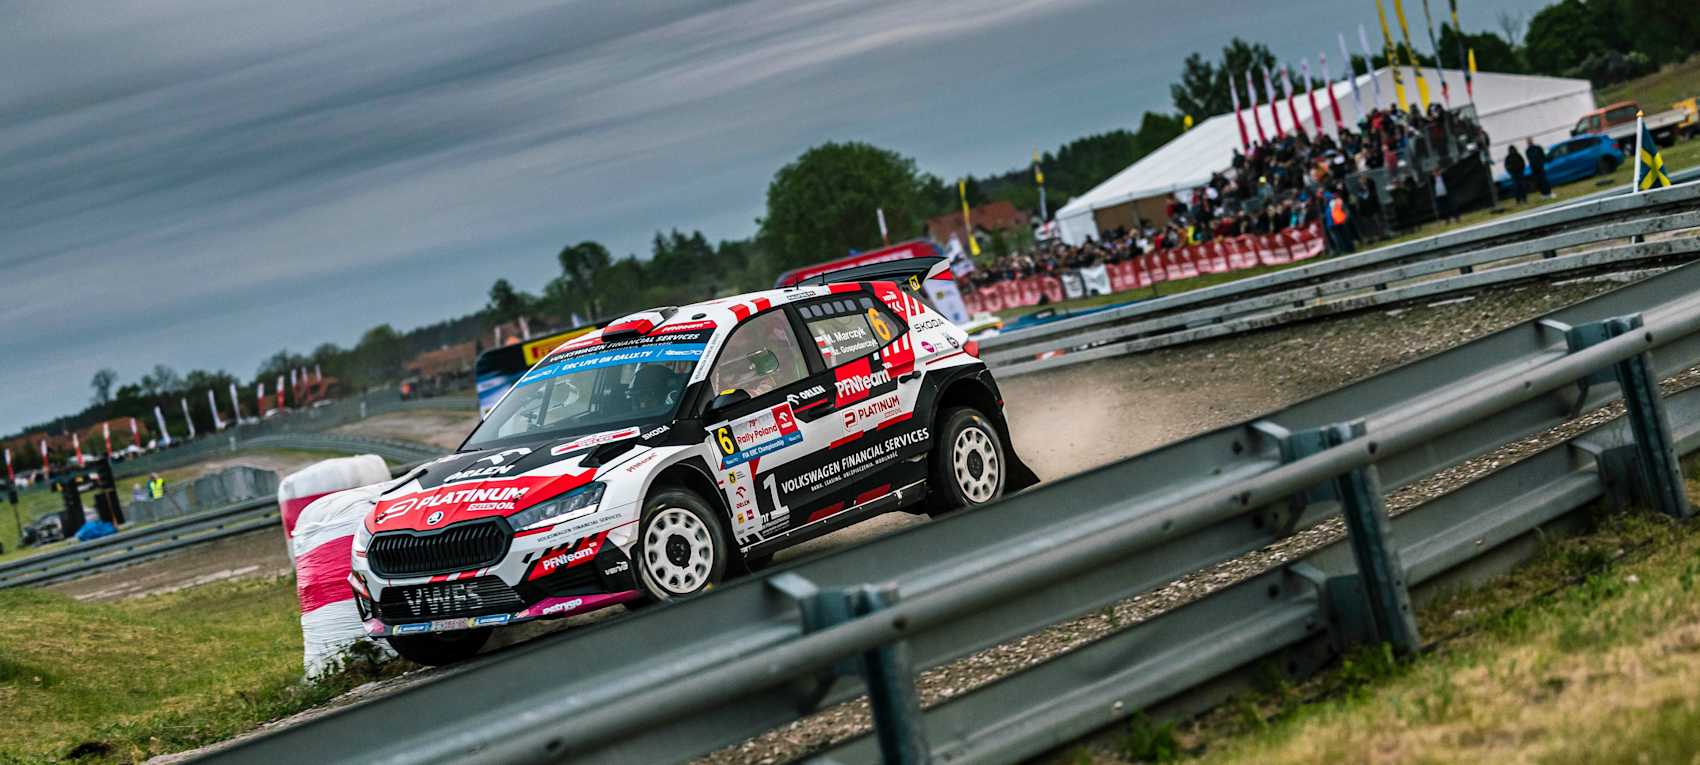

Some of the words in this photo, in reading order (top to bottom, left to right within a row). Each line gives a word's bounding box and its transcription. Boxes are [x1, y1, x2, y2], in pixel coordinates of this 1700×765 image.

[834, 327, 867, 343] Marczyk
[867, 308, 891, 340] 6
[608, 337, 655, 349] FINANCIAL
[655, 333, 701, 342] SERVICES
[799, 384, 827, 400] ORLEN
[834, 369, 891, 398] PFNteam
[857, 395, 900, 420] PLATINUM
[717, 427, 735, 455] 6
[736, 431, 755, 446] Rally
[754, 424, 779, 440] Poland
[758, 439, 785, 454] Championship
[781, 460, 841, 494] VOLKSWAGEN
[841, 443, 885, 468] FINANCIAL
[884, 427, 930, 452] SERVICES
[416, 487, 529, 510] PLATINUM
[494, 502, 515, 510] OIL
[762, 472, 790, 520] 1
[542, 547, 594, 571] PFNteam
